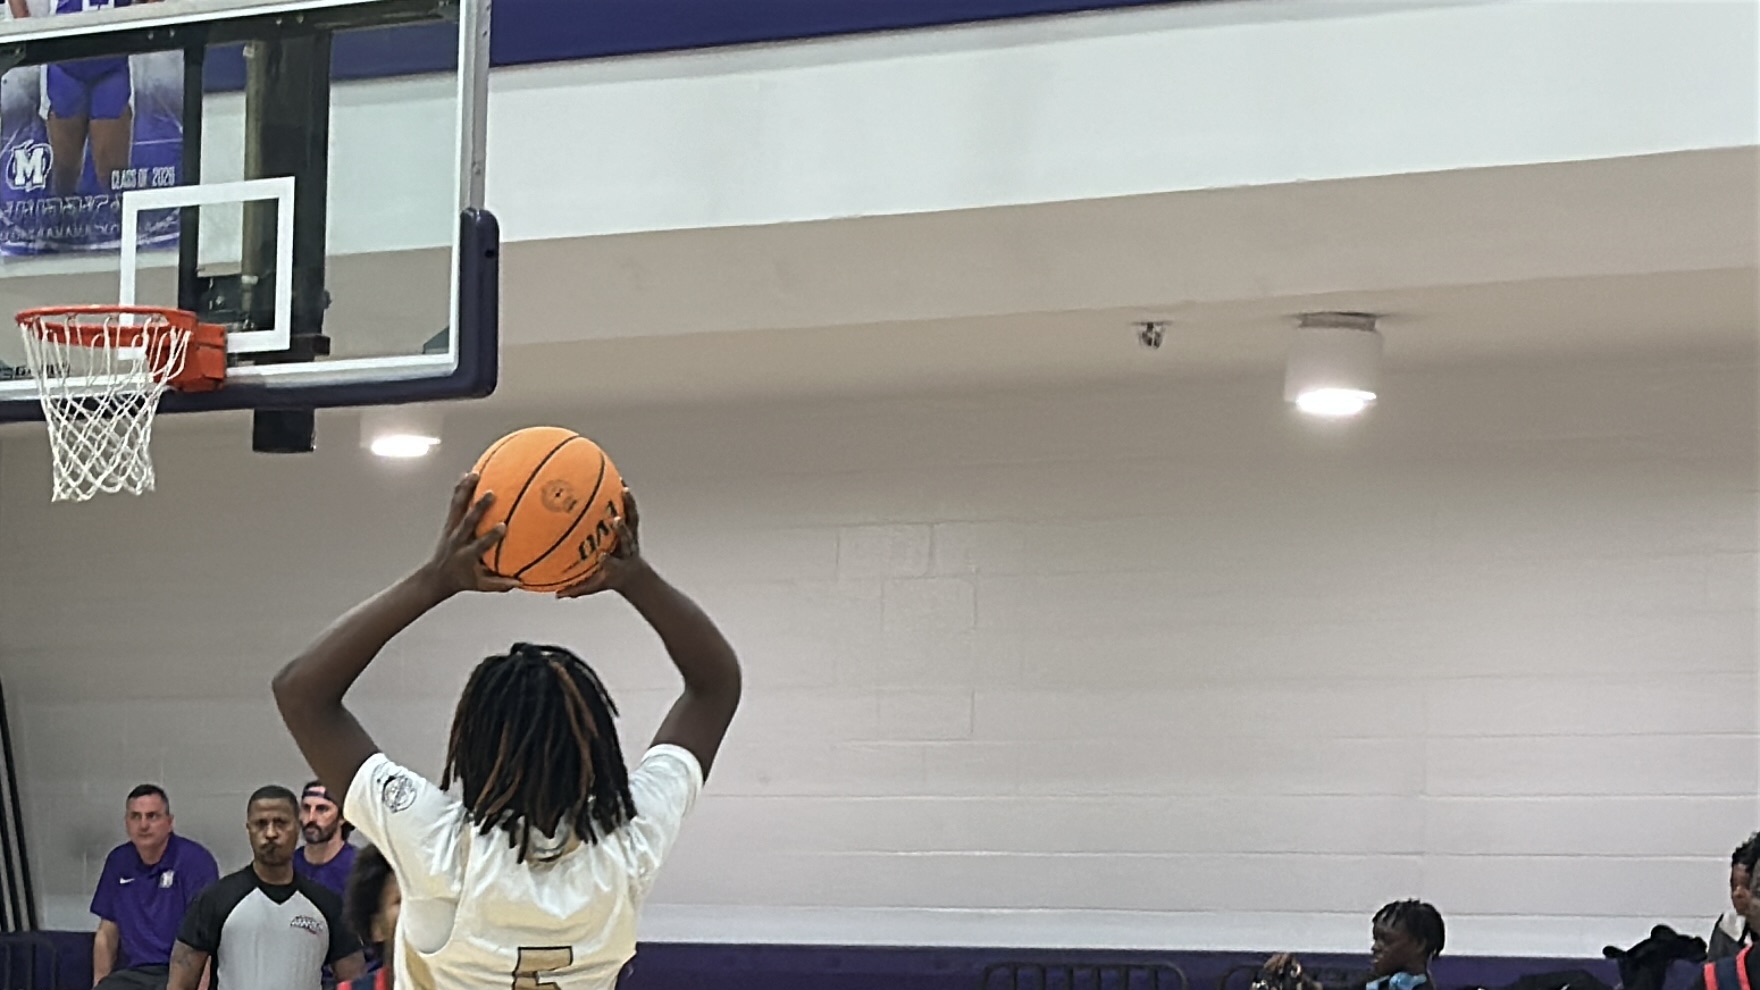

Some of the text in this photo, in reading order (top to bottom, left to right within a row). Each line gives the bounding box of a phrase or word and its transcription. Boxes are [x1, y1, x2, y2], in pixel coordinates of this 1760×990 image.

[14, 148, 43, 185] M
[111, 168, 136, 190] CLASS
[138, 167, 149, 188] OF
